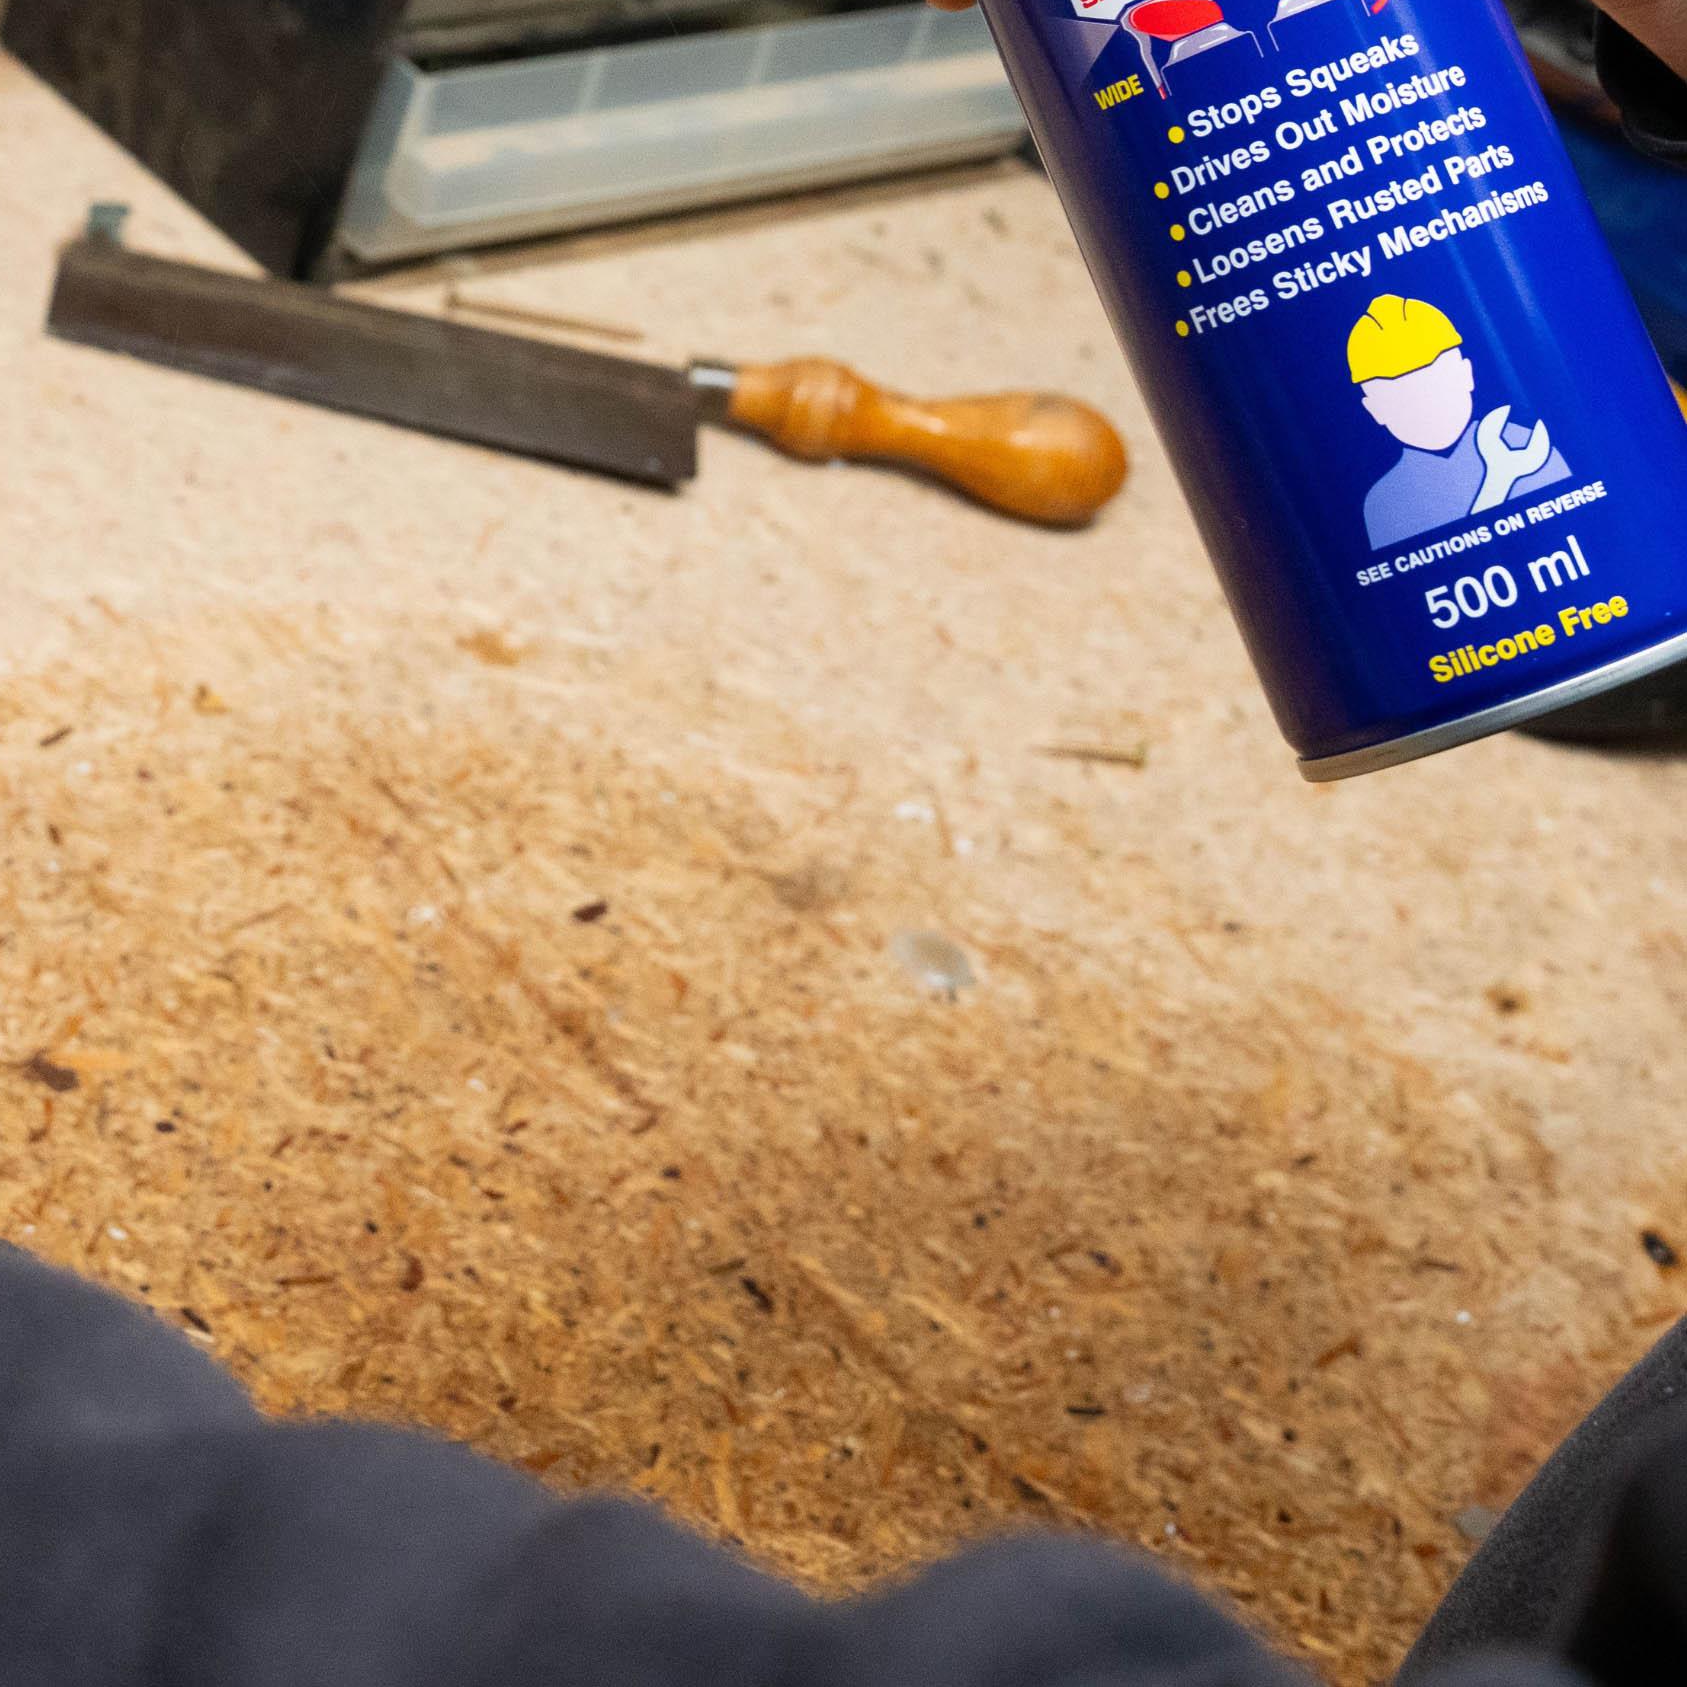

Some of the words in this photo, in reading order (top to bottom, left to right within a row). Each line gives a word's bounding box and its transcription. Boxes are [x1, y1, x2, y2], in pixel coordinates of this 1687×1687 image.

[1094, 75, 1144, 111] WIDE
[1171, 139, 1271, 196] Drives
[1275, 110, 1335, 149] Out
[1346, 64, 1467, 122] Moisture
[1186, 83, 1283, 140] Stops
[1284, 33, 1420, 100] Squeaks
[1188, 184, 1295, 238] Cleans
[1301, 145, 1365, 194] and
[1372, 105, 1487, 165] Protects
[1193, 216, 1324, 285] Loosens
[1327, 172, 1442, 230] Rusted
[1445, 141, 1514, 184] Parts
[1188, 287, 1269, 337] Frees
[1272, 242, 1372, 300] Sticky
[1380, 180, 1549, 259] Mechanisms
[1356, 562, 1393, 587] SEE
[1395, 524, 1493, 573] CAUTIONS
[1494, 514, 1526, 536] ON
[1528, 480, 1608, 525] REVERSE
[1424, 565, 1518, 630] 500
[1527, 534, 1591, 594] ml
[1428, 623, 1556, 684] Silicone
[1557, 595, 1629, 638] Free
